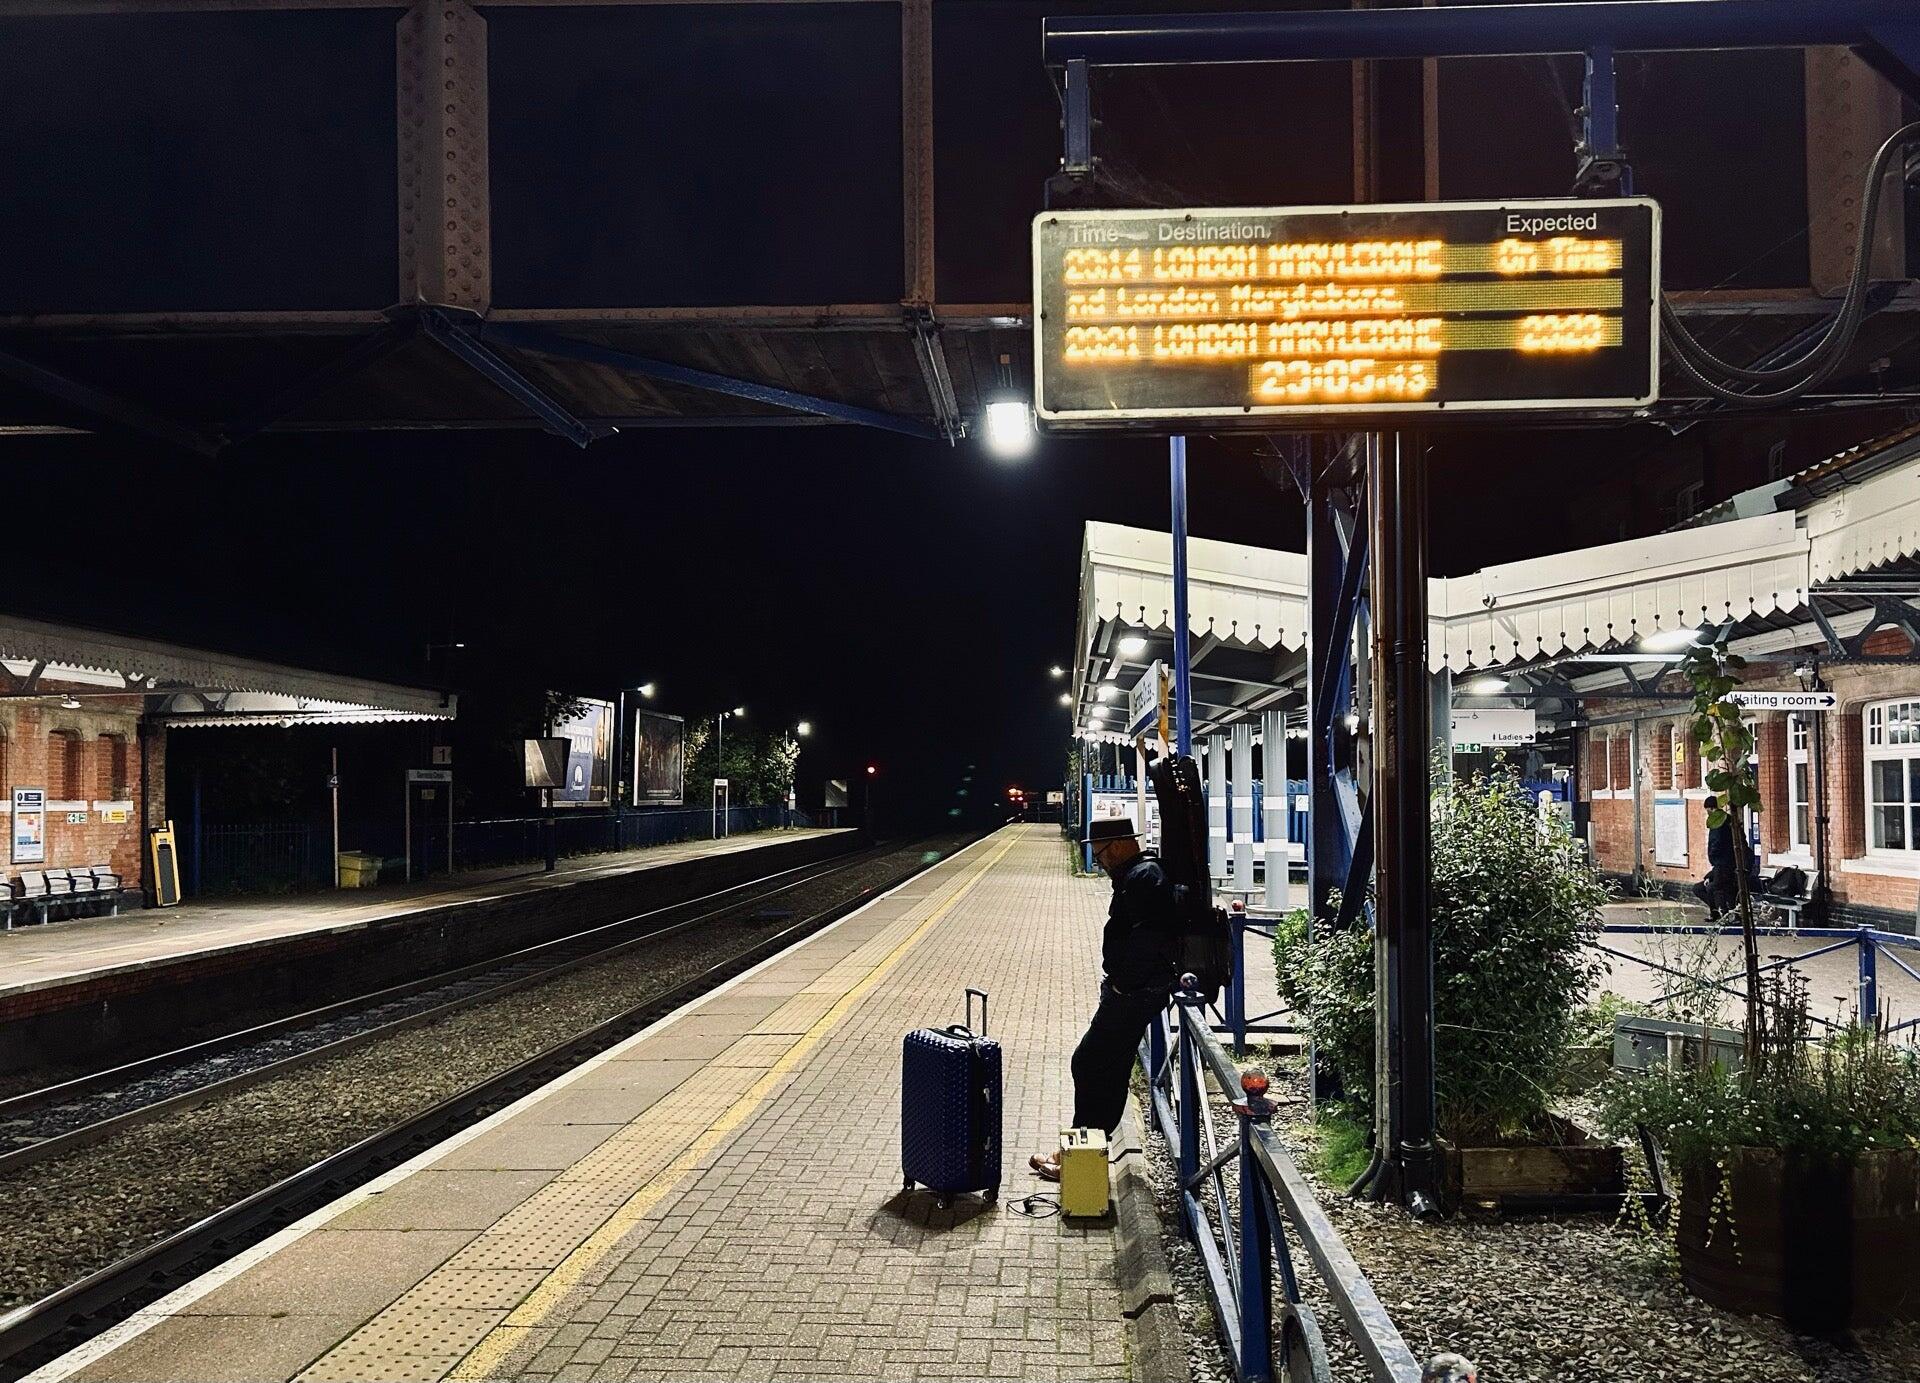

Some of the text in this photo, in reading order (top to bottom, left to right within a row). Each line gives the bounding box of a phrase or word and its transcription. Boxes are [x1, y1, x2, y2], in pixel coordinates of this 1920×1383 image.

[1069, 221, 1265, 243] Time Destination
[1507, 212, 1598, 236] Expected
[1153, 245, 1258, 279] LONDON
[1500, 238, 1538, 273] On
[1153, 322, 1258, 356] LONDON
[1782, 696, 1817, 705] room
[1498, 733, 1523, 741] Ladies
[439, 748, 446, 762] 1
[330, 775, 338, 785] 4
